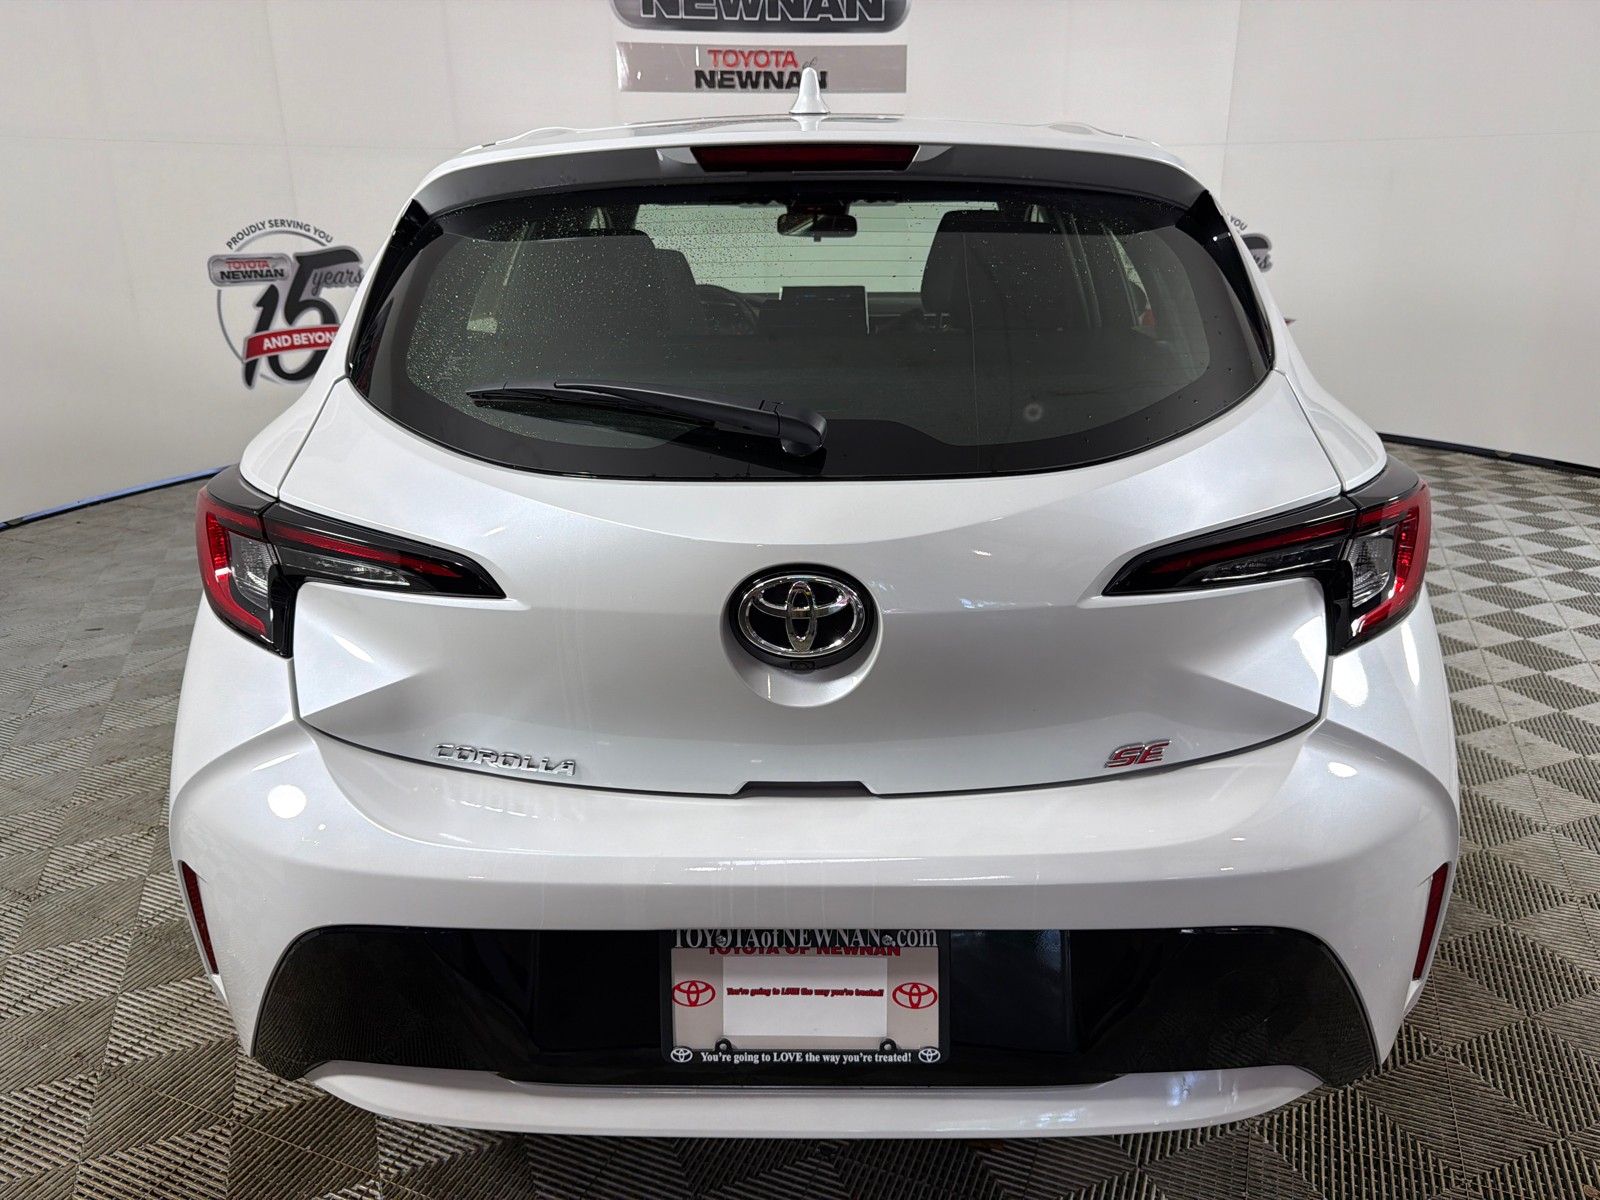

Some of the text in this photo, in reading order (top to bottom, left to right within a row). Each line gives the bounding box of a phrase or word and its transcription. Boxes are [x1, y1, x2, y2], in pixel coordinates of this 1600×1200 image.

[640, 0, 885, 21] NEWNAN
[708, 49, 798, 68] TOYOTA
[1230, 214, 1248, 231] YOU
[226, 219, 334, 250] PROUDLY SERVING YOU
[220, 269, 284, 280] NEWNAN
[226, 260, 269, 270] TOYOTA
[311, 269, 363, 297] years
[263, 332, 337, 351] AND BEYON
[431, 743, 577, 776] COROLLA
[1103, 739, 1172, 768] SE
[781, 987, 800, 996] LOVE
[814, 988, 830, 997] way
[700, 1051, 912, 1065] You're going to LOVE the way you're treated!
